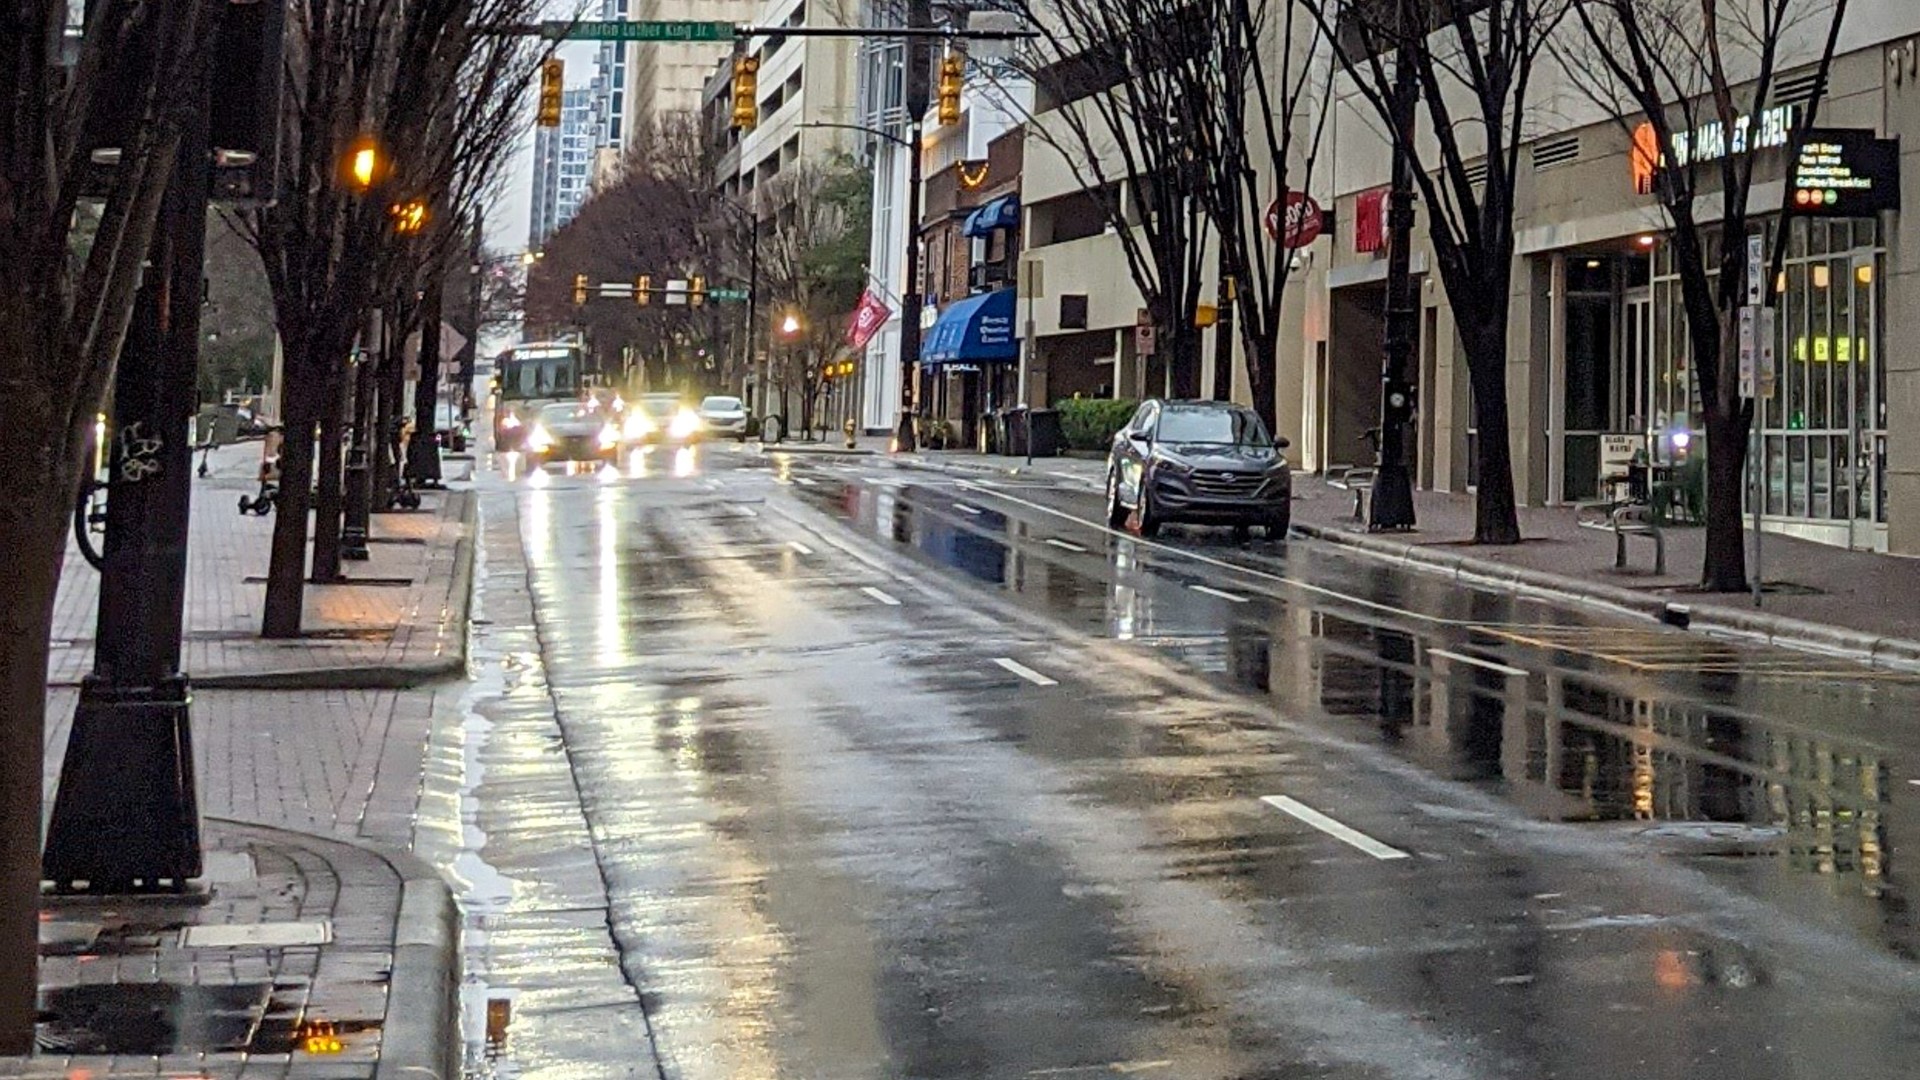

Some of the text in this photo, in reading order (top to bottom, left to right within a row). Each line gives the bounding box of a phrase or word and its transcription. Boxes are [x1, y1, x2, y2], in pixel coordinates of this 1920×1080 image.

[581, 23, 618, 36] Martin
[623, 22, 661, 36] Luther
[665, 23, 692, 40] King
[1695, 115, 1750, 163] MARET
[1761, 105, 1793, 147] DELI
